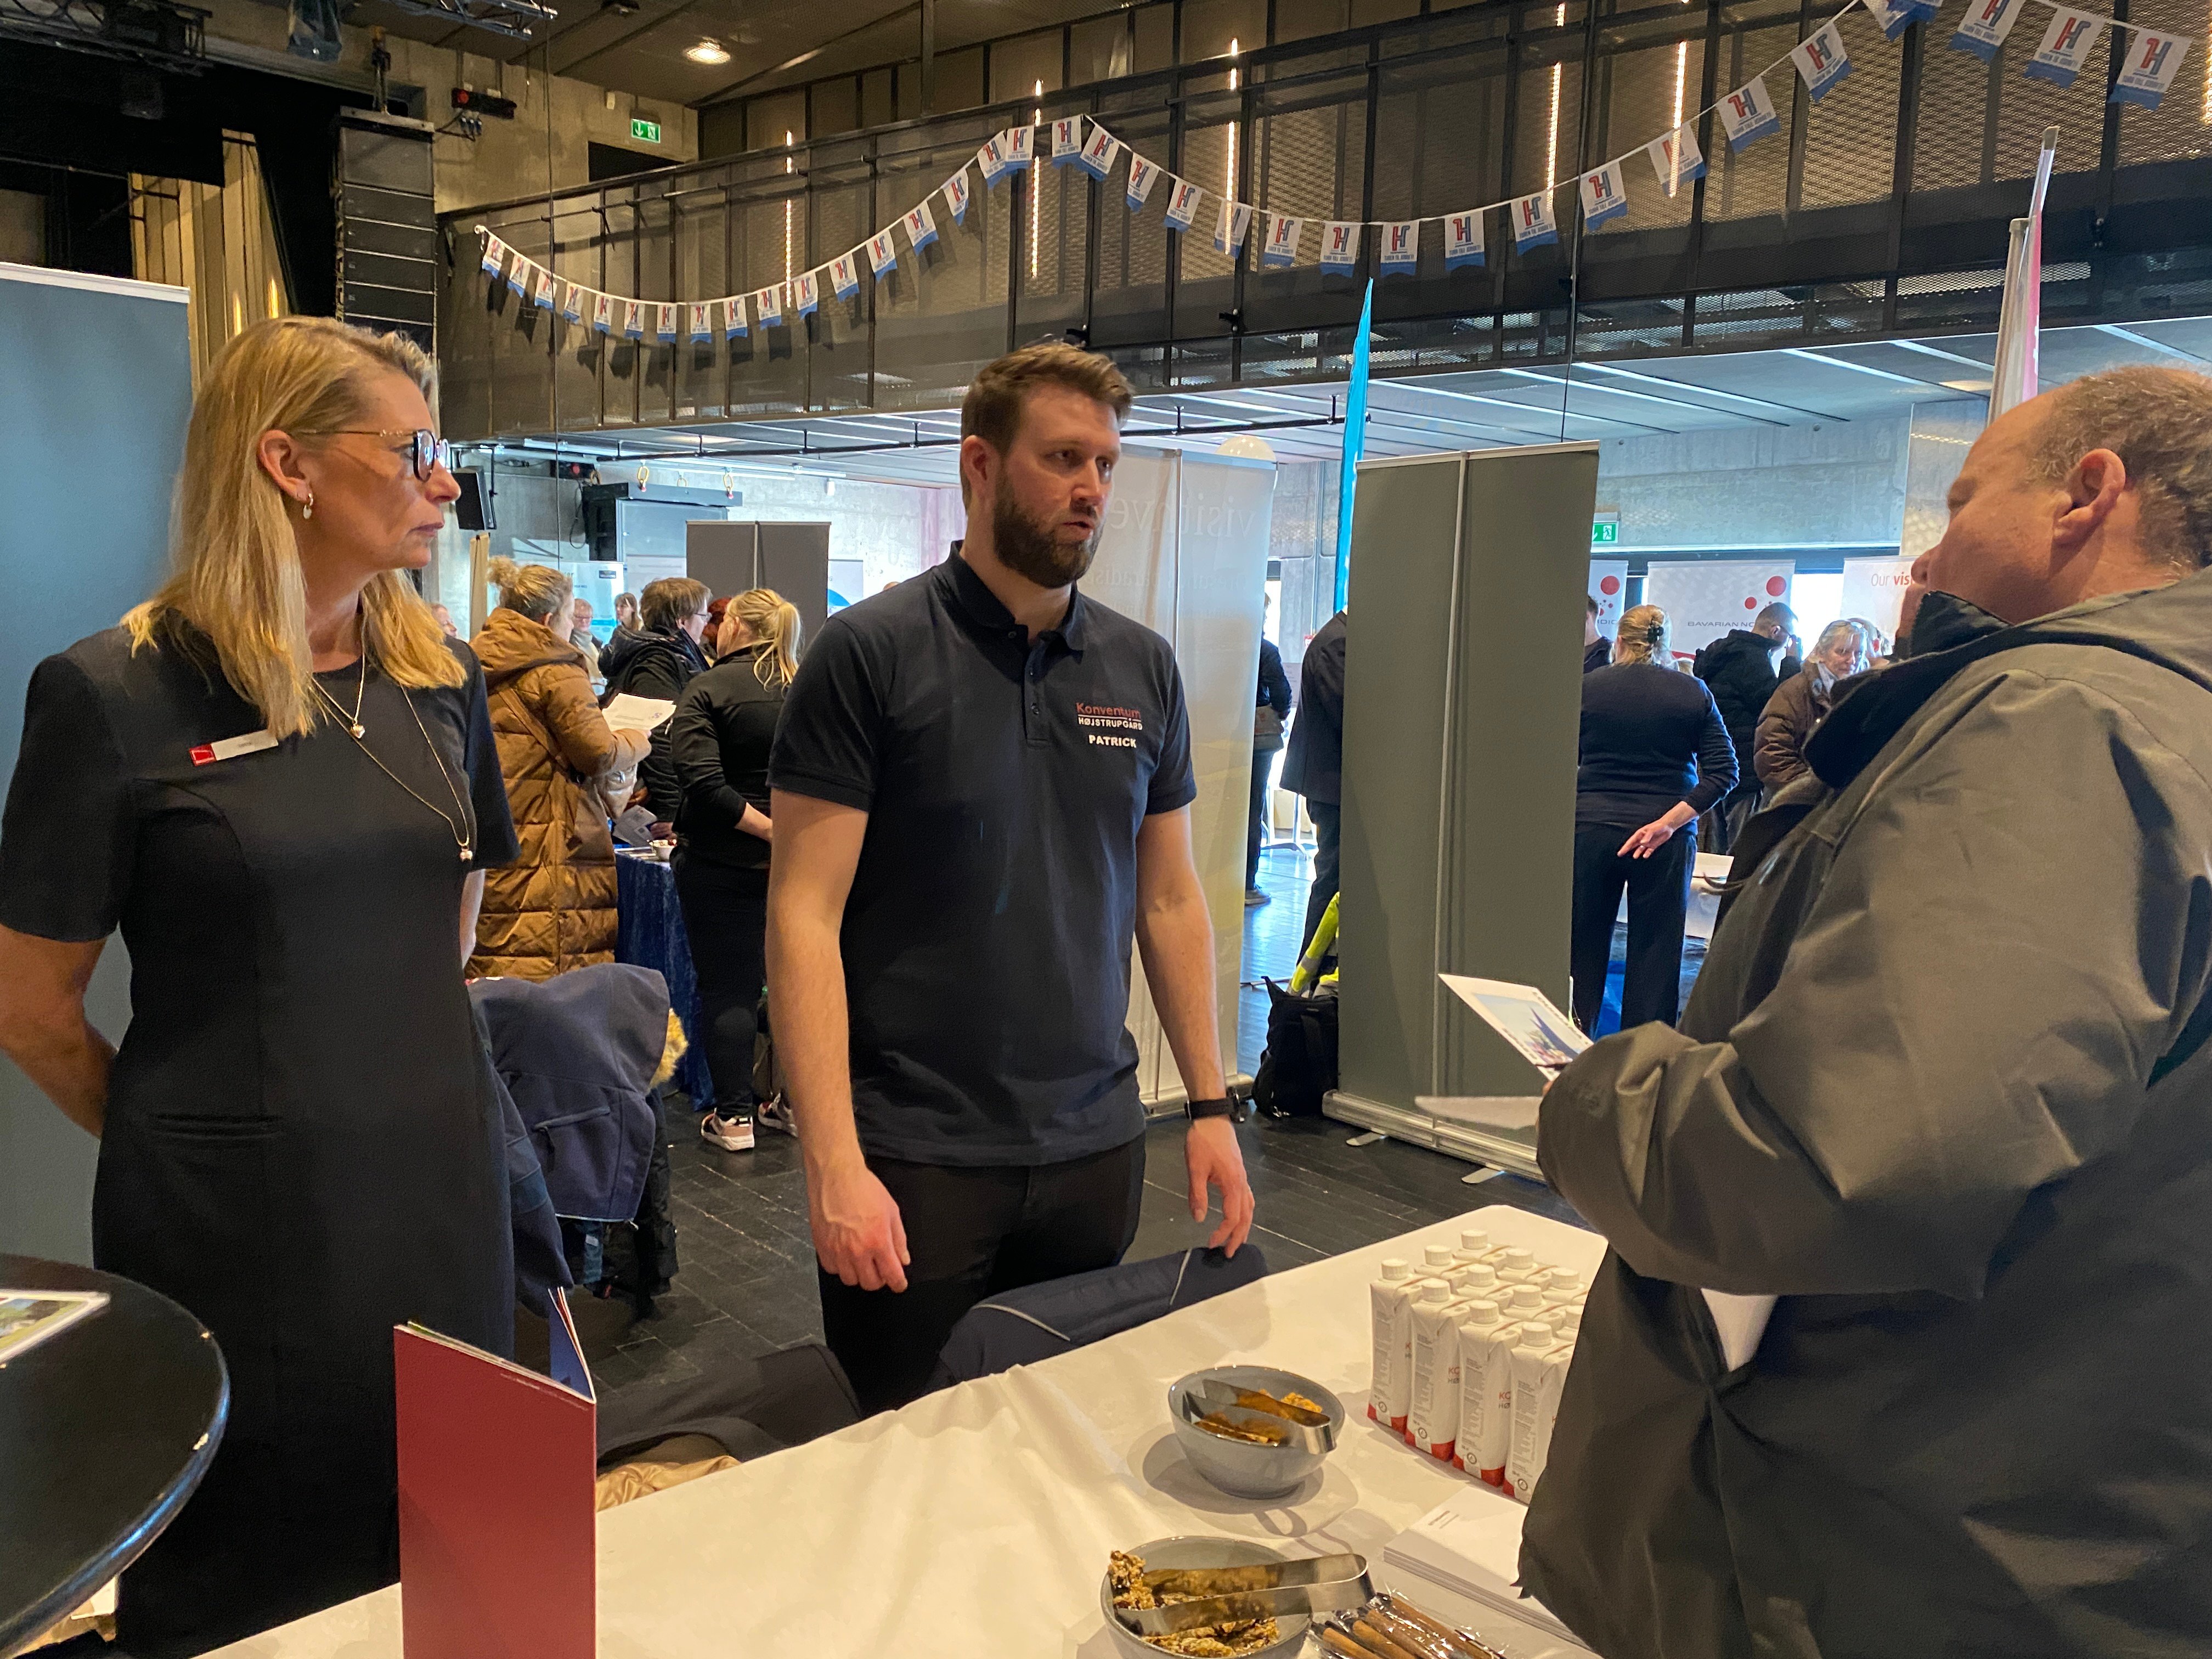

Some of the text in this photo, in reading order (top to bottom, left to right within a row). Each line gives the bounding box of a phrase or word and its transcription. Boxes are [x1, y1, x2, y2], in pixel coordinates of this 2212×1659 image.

[1871, 572, 1914, 586] Our vis
[1076, 702, 1141, 719] Konventum
[1078, 717, 1143, 731] HØJSTRUPGÅRD
[1088, 734, 1137, 748] PATRICK
